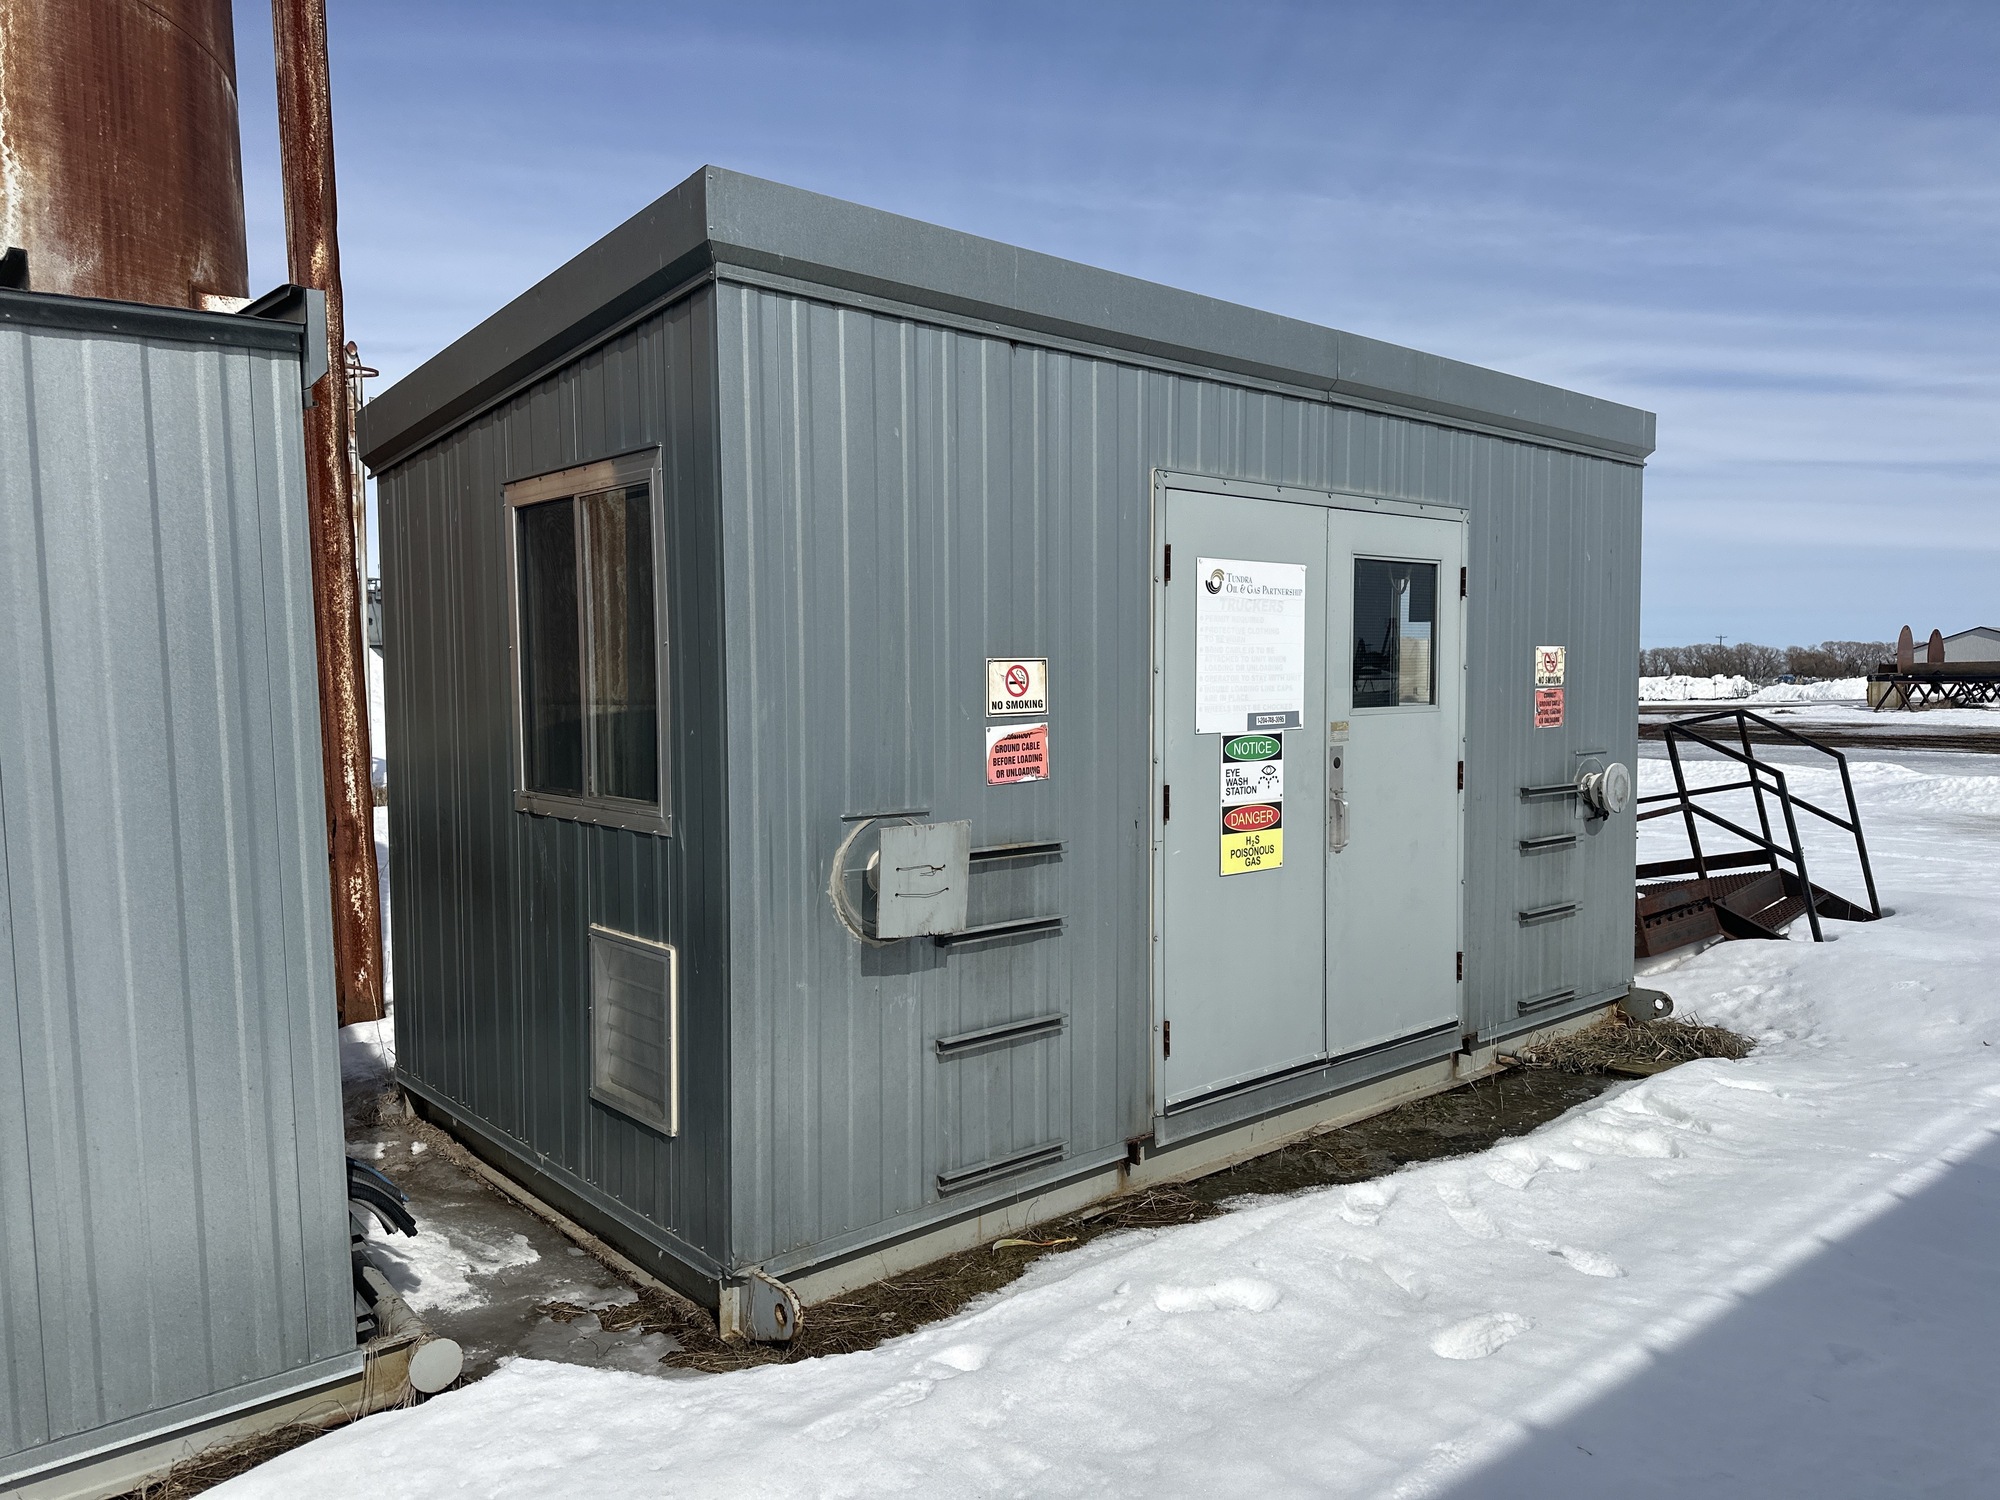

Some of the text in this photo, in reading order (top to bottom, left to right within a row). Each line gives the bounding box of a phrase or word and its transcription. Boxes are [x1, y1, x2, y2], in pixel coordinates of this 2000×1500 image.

[1227, 573, 1252, 583] TUNDRA
[1226, 584, 1302, 596] OIL & GAS PARTNERSHIP
[1220, 597, 1284, 613] TRUCKERS
[992, 700, 1043, 710] NO SMOKING
[995, 741, 1040, 753] GROUND CABLE
[1234, 741, 1272, 755] NOTICE
[993, 754, 1042, 766] BEFORE LOADING
[996, 766, 1040, 778] OR UNLOADING
[1226, 768, 1240, 777] EYE
[1226, 777, 1248, 786] WASH
[1226, 786, 1257, 796] STATION
[1231, 810, 1273, 826] DANGER
[1231, 845, 1274, 859] POISONOUS
[1245, 856, 1261, 866] GAS
